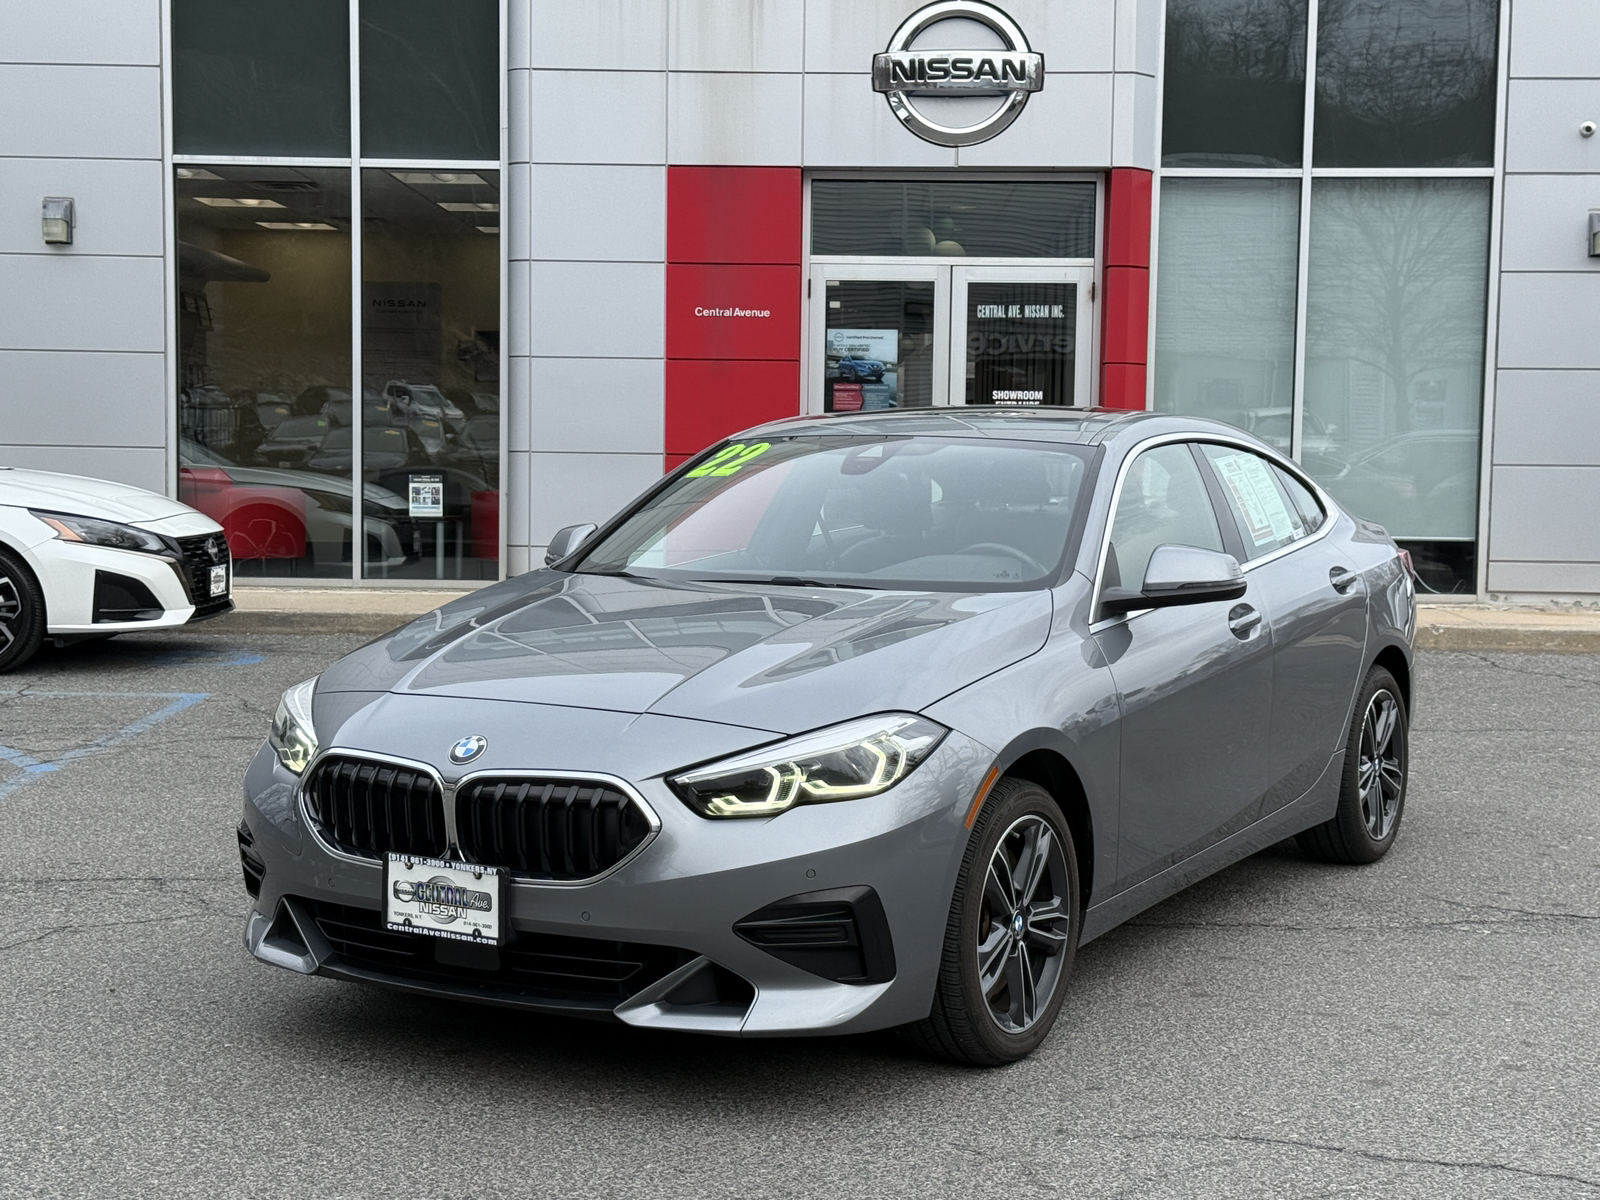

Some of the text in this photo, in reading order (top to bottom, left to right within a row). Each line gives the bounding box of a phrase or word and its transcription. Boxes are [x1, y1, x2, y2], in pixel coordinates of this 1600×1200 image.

[890, 58, 1027, 83] NISSAN
[372, 299, 426, 308] NISSAN
[977, 304, 1065, 318] CENTRAL AVE. NISSAN INC.
[694, 306, 771, 318] Central Avenue
[992, 390, 1043, 400] SHOWROOM
[685, 443, 771, 478] 22
[389, 853, 408, 864] (914)
[410, 856, 445, 868] 961-3900
[416, 882, 468, 907] CENTRAL
[470, 893, 490, 909] Ave.
[419, 902, 467, 919] NISSAN
[387, 923, 498, 946] CentralAveNissan.com
